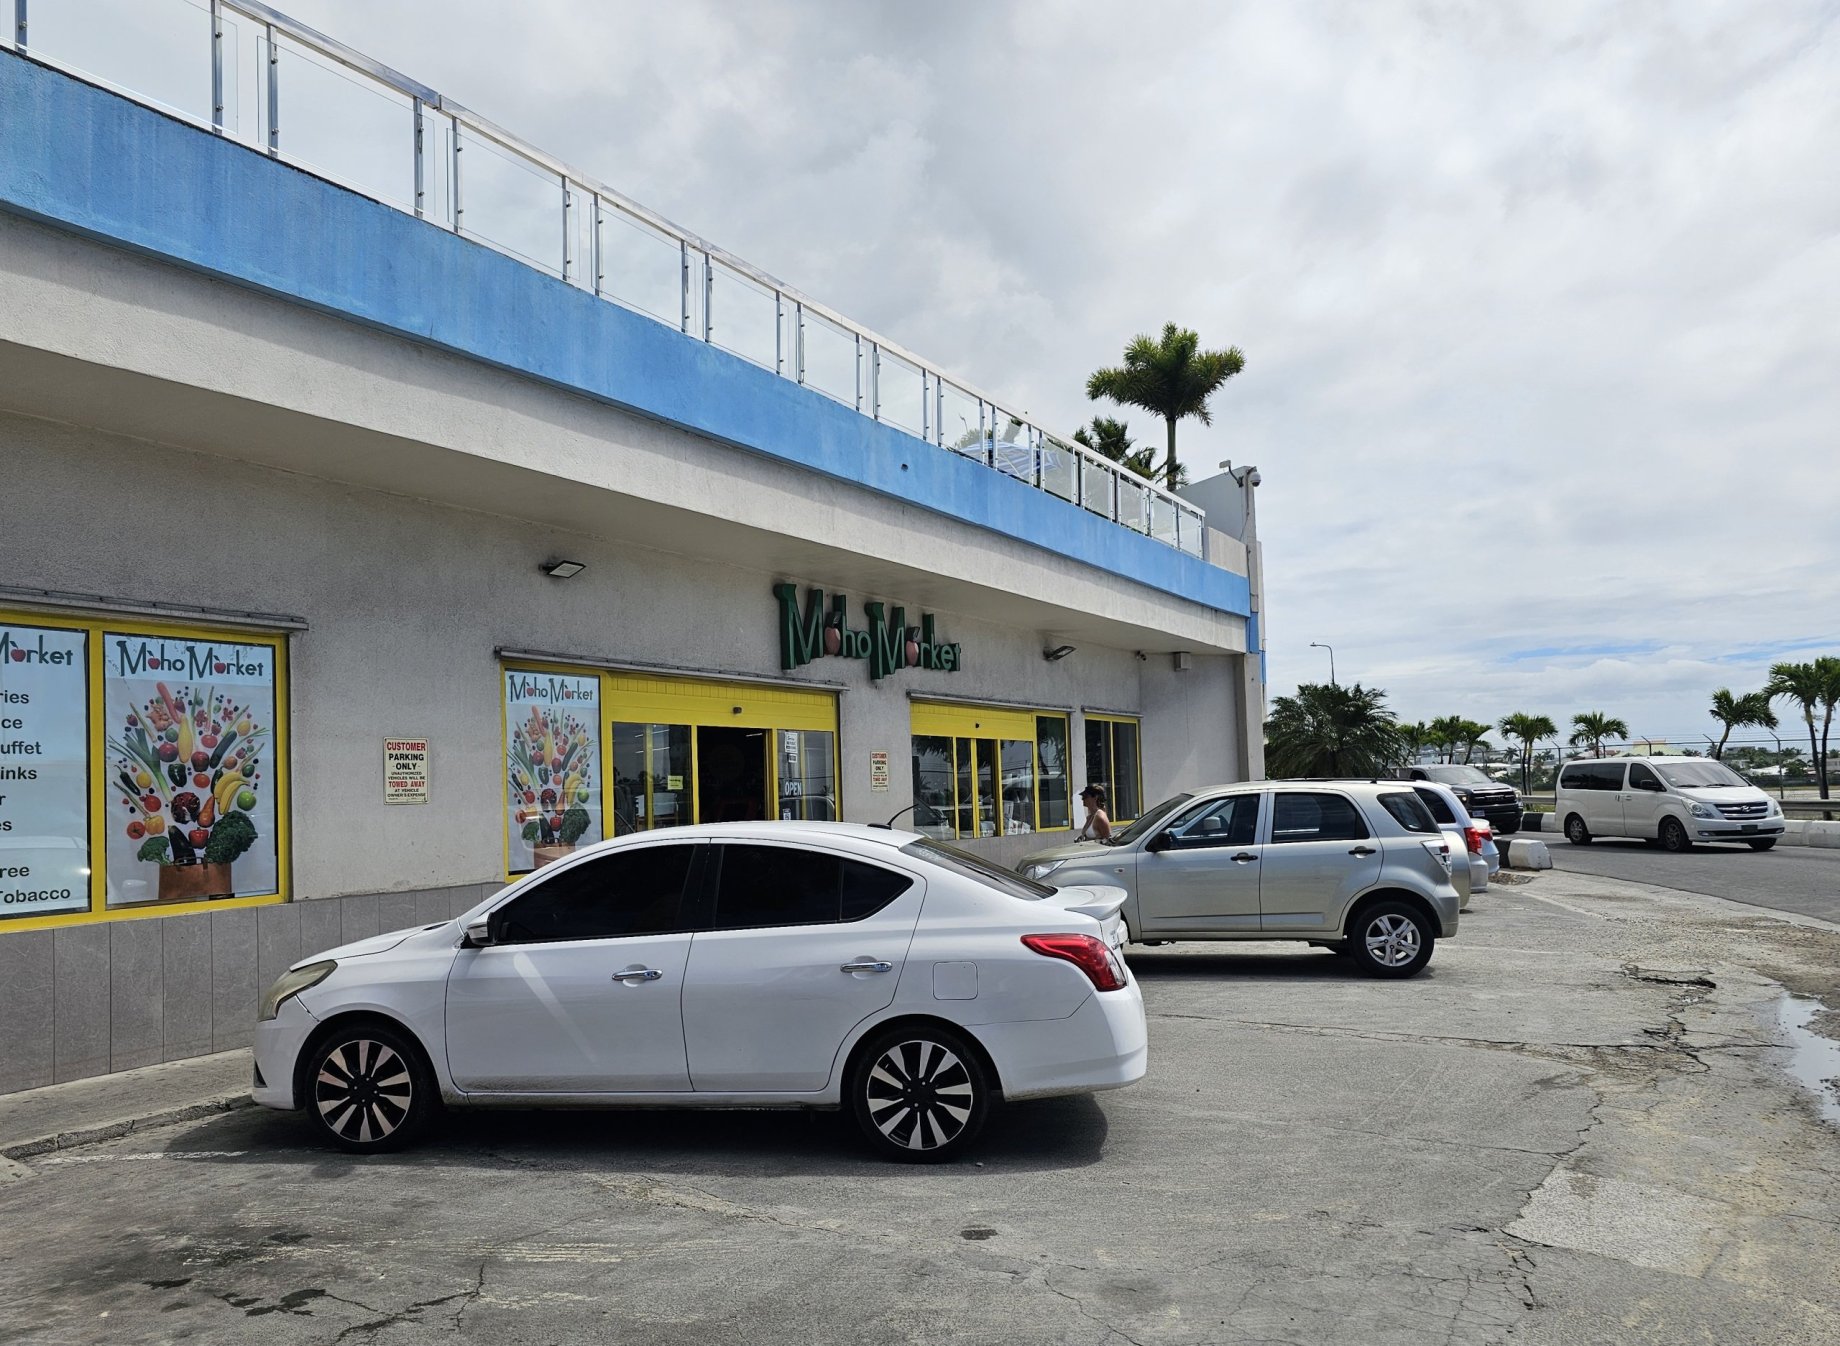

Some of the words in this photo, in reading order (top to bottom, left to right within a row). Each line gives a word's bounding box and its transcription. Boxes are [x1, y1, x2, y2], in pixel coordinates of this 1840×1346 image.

[387, 742, 426, 751] CUSTOMER
[389, 753, 424, 761] PARKING
[784, 781, 802, 796] OPEN
[0, 889, 71, 904] obacco
